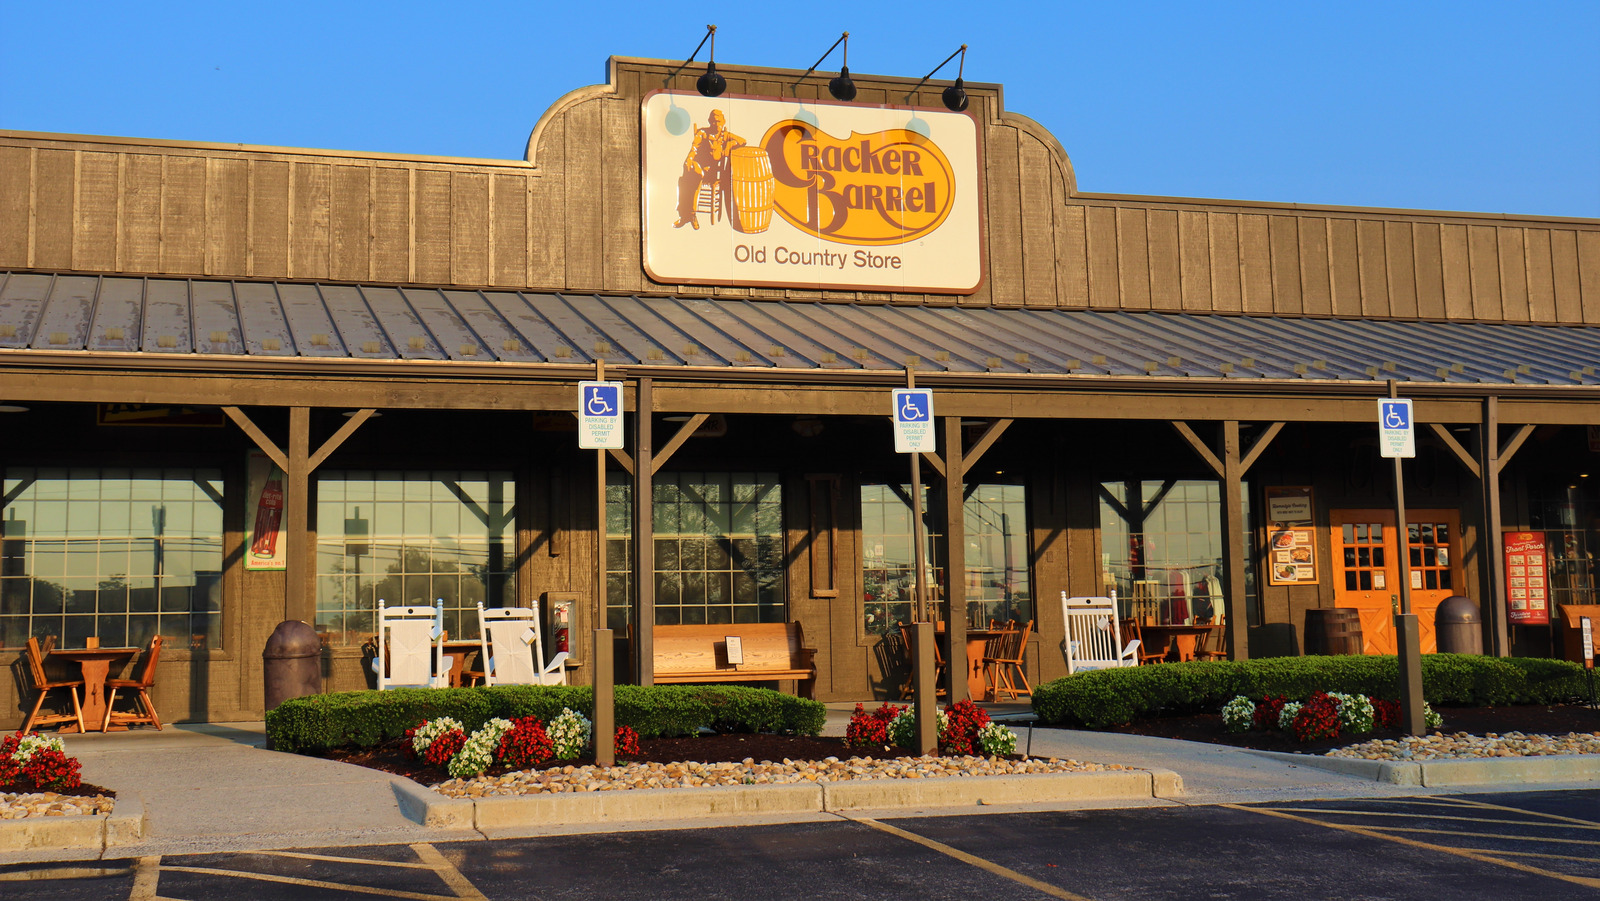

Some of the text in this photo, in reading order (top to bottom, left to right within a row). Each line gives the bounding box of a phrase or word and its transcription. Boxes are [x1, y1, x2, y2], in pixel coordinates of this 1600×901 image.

[764, 124, 924, 188] Cracker
[805, 169, 937, 235] Barrel
[734, 244, 902, 270] Old Country Store
